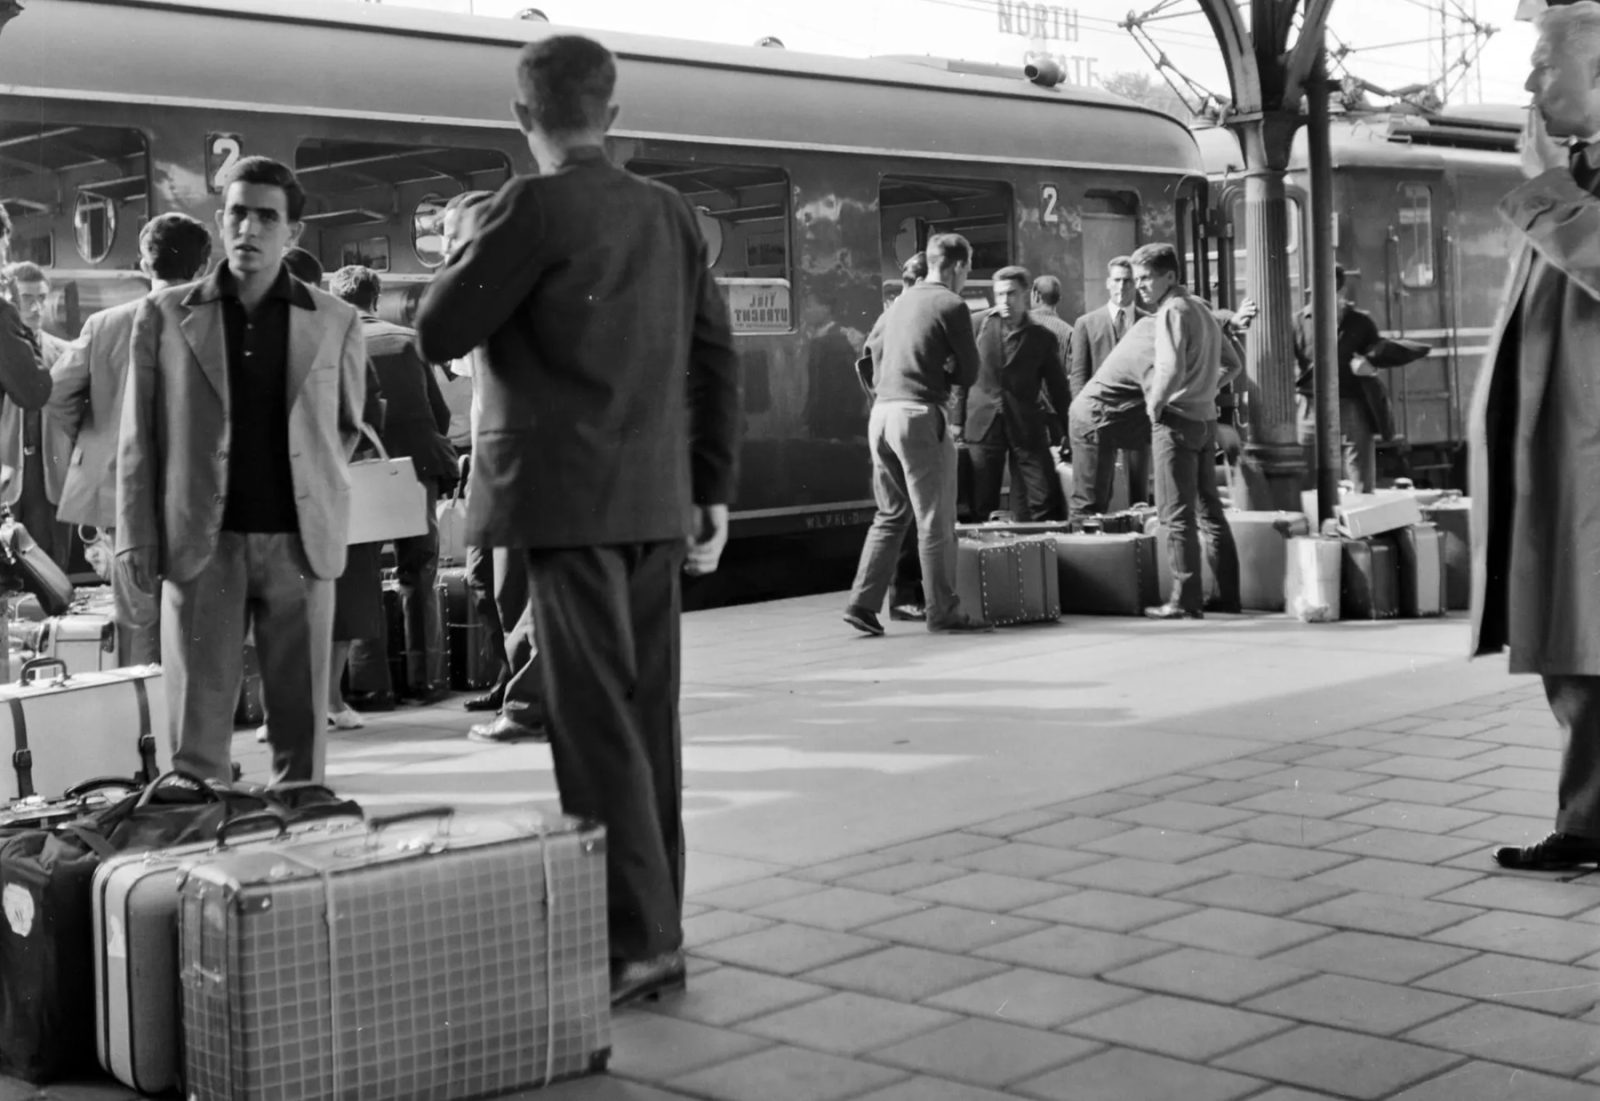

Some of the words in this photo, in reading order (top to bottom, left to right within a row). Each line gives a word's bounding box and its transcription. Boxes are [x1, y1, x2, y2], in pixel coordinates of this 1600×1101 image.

[998, 0, 1078, 42] NORTH
[213, 138, 239, 187] 2
[1043, 187, 1058, 222] 2
